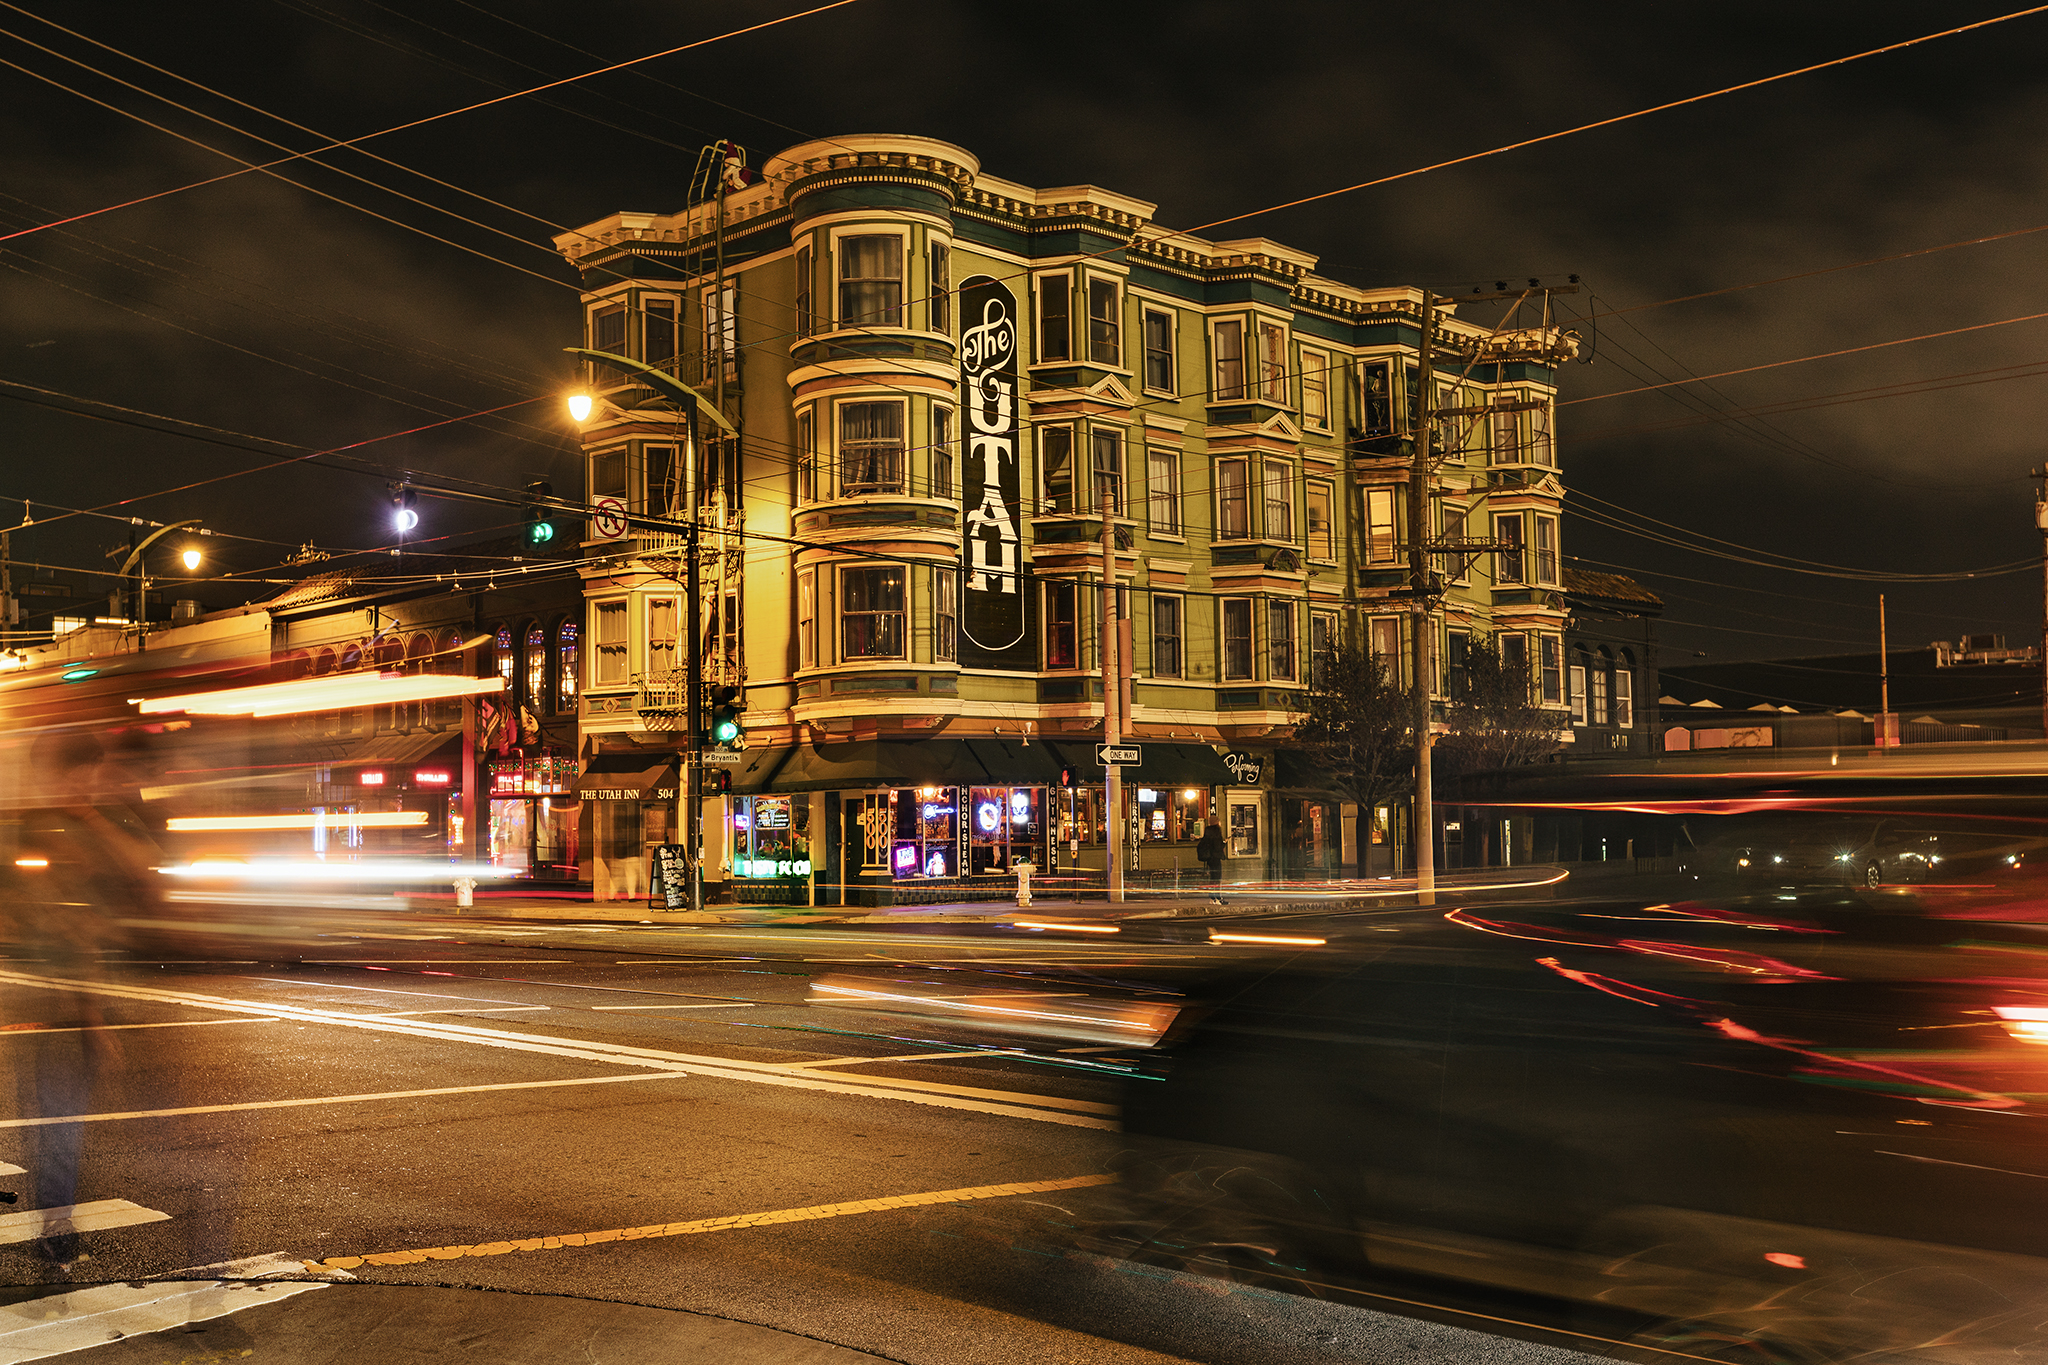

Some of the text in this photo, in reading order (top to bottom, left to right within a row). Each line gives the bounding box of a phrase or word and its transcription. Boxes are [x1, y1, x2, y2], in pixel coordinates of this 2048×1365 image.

[962, 298, 1015, 402] The
[966, 374, 1019, 595] UTAH
[1110, 751, 1136, 759] ONE WAY
[1223, 753, 1260, 783] Performing
[580, 790, 640, 800] THE UTAH INN
[658, 789, 674, 799] 504
[961, 784, 969, 829] NCHOR
[1049, 786, 1057, 865] GUINNESS
